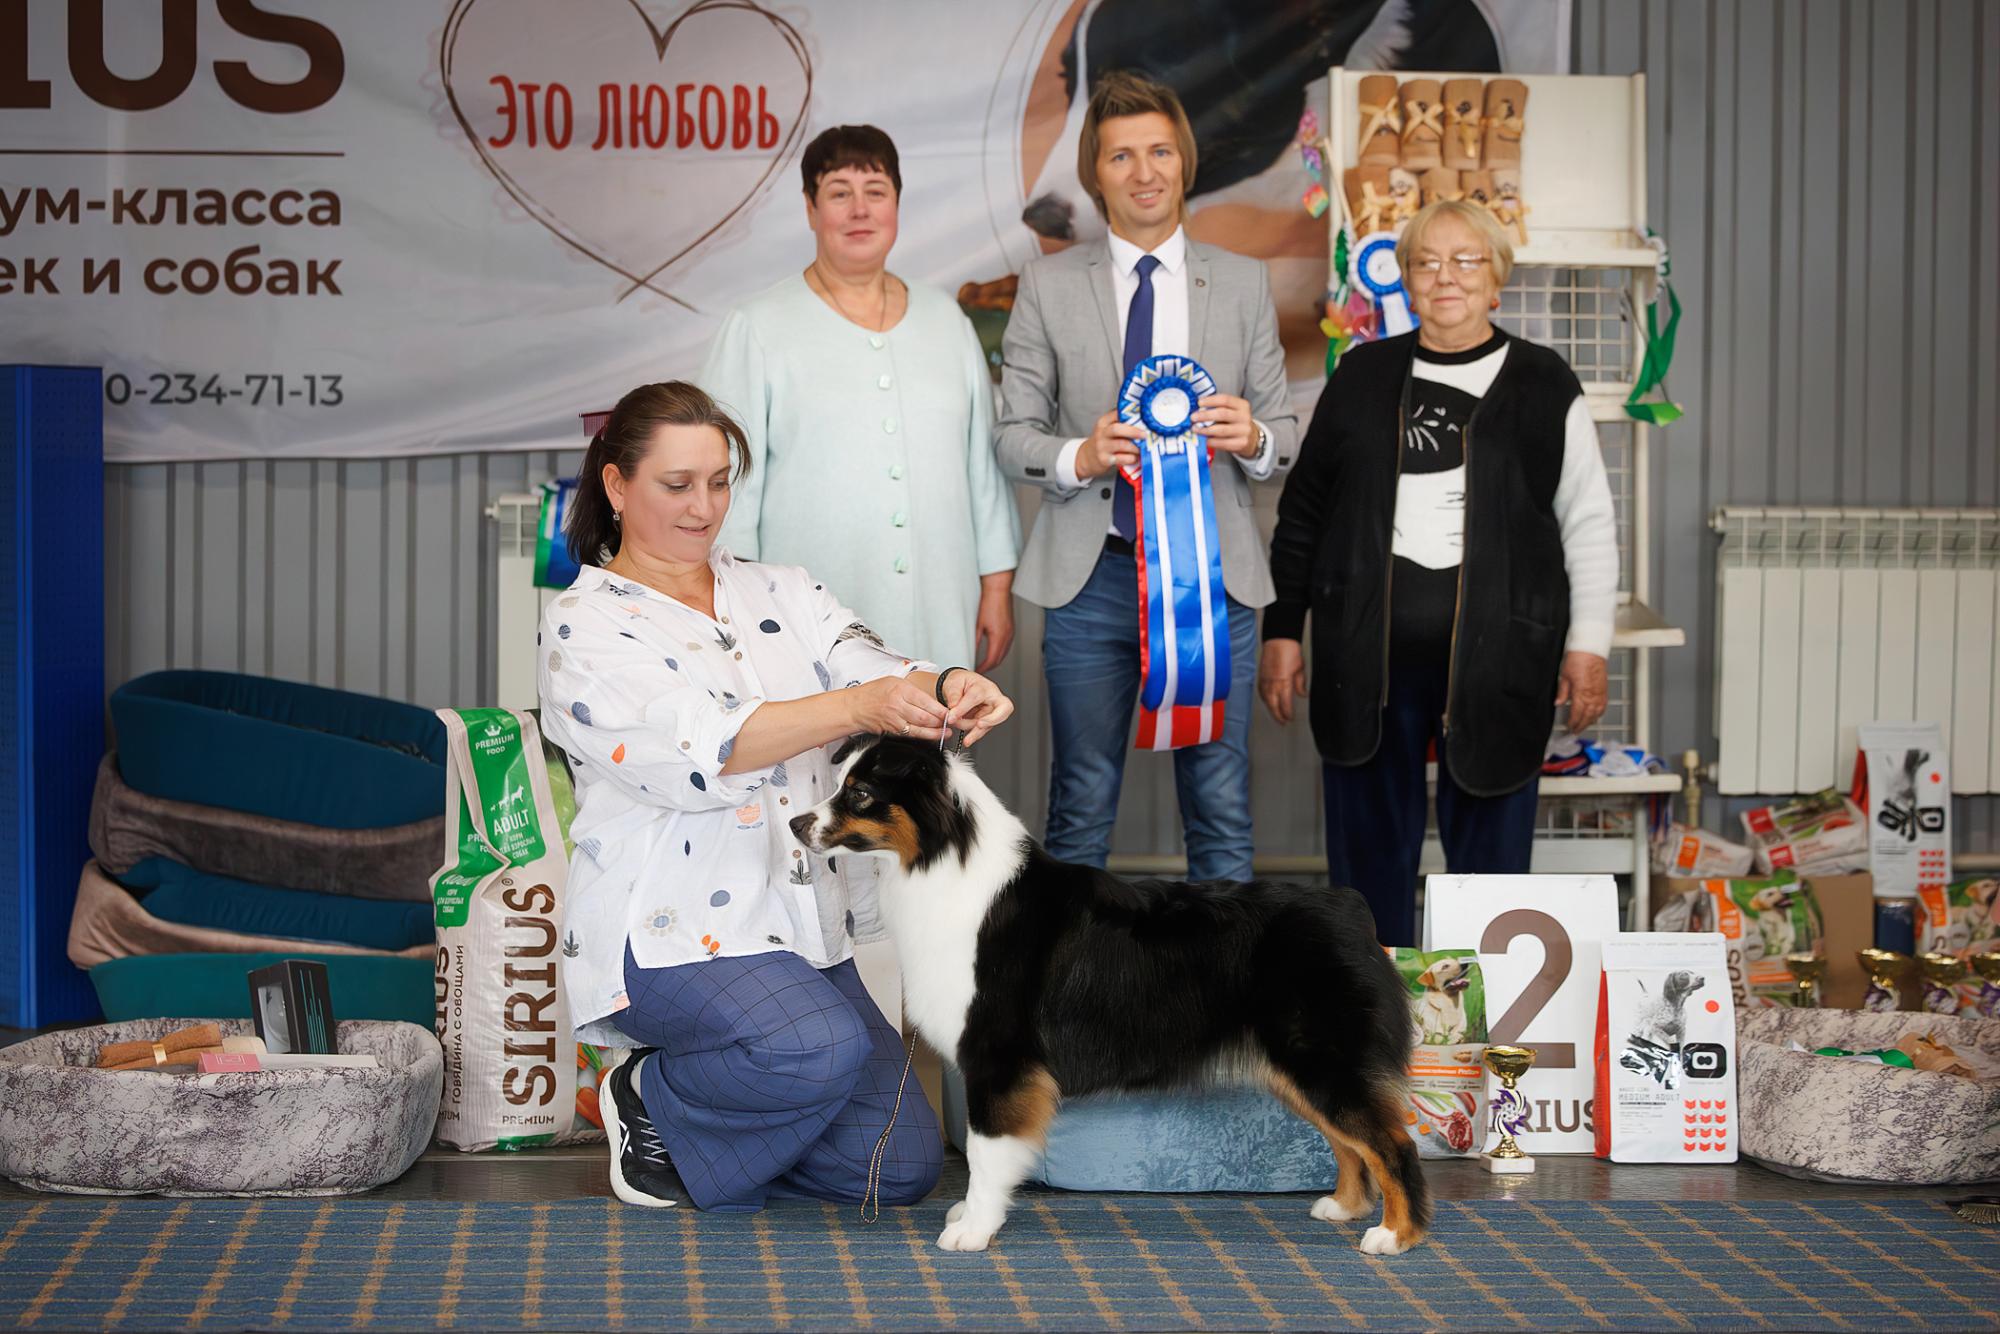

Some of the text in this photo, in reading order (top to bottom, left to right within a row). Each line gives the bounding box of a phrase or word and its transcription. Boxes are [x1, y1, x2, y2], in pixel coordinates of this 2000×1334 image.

[489, 75, 780, 151] ЭТО ЛЮБОВЬ
[82, 258, 120, 294] и
[143, 244, 343, 295] собак
[105, 373, 343, 406] 0-234-71-13
[475, 733, 514, 750] PREMIUM
[487, 746, 505, 755] FOOD
[494, 809, 529, 836] ADULT
[453, 945, 464, 1018] ОВОЩАМИ
[502, 883, 557, 1106] SIRIUS
[1479, 908, 1576, 1068] 2
[452, 1033, 463, 1104] ГОВЯДИНА
[502, 1115, 554, 1125] PREMIUM
